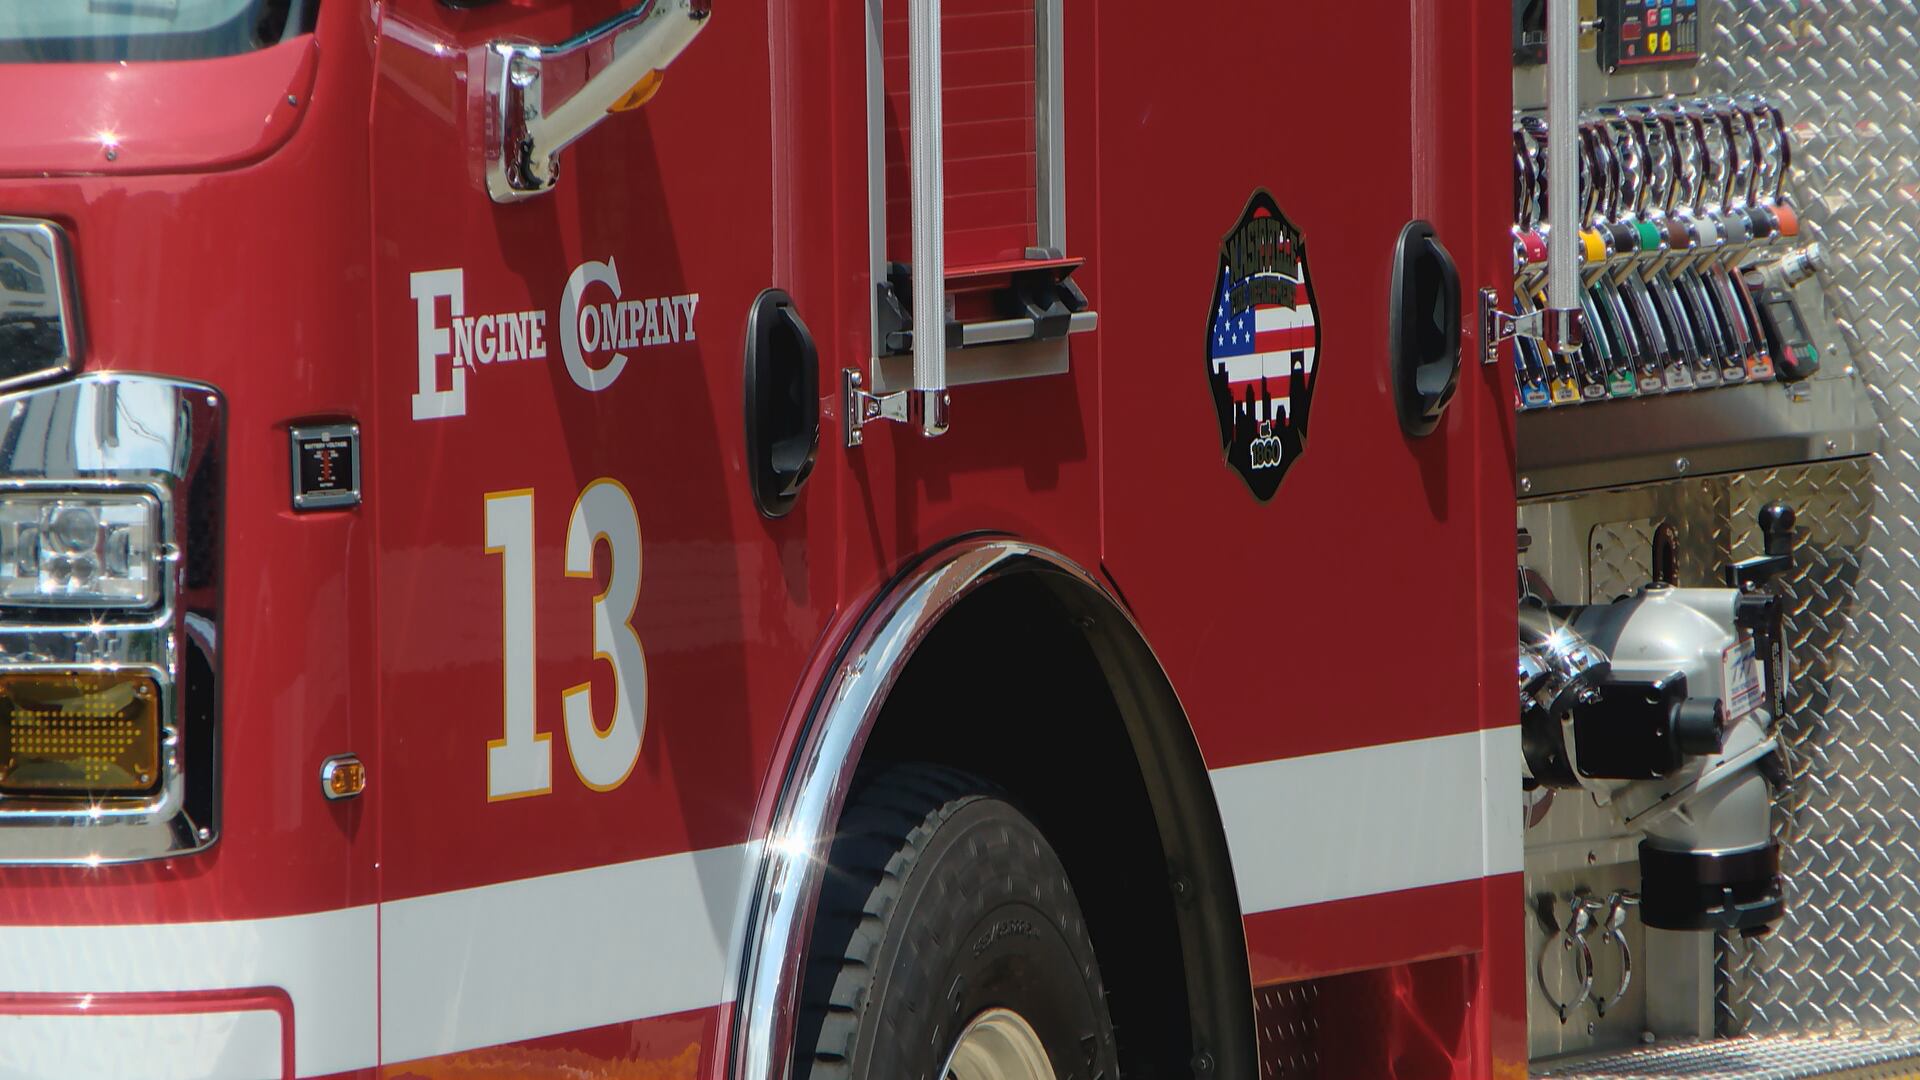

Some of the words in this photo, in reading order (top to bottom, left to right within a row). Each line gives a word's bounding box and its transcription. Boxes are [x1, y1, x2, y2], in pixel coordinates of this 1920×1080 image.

[410, 268, 546, 421] ENGINE
[560, 255, 699, 392] COMPANY
[1251, 437, 1281, 468] 1860
[484, 477, 648, 803] 13
